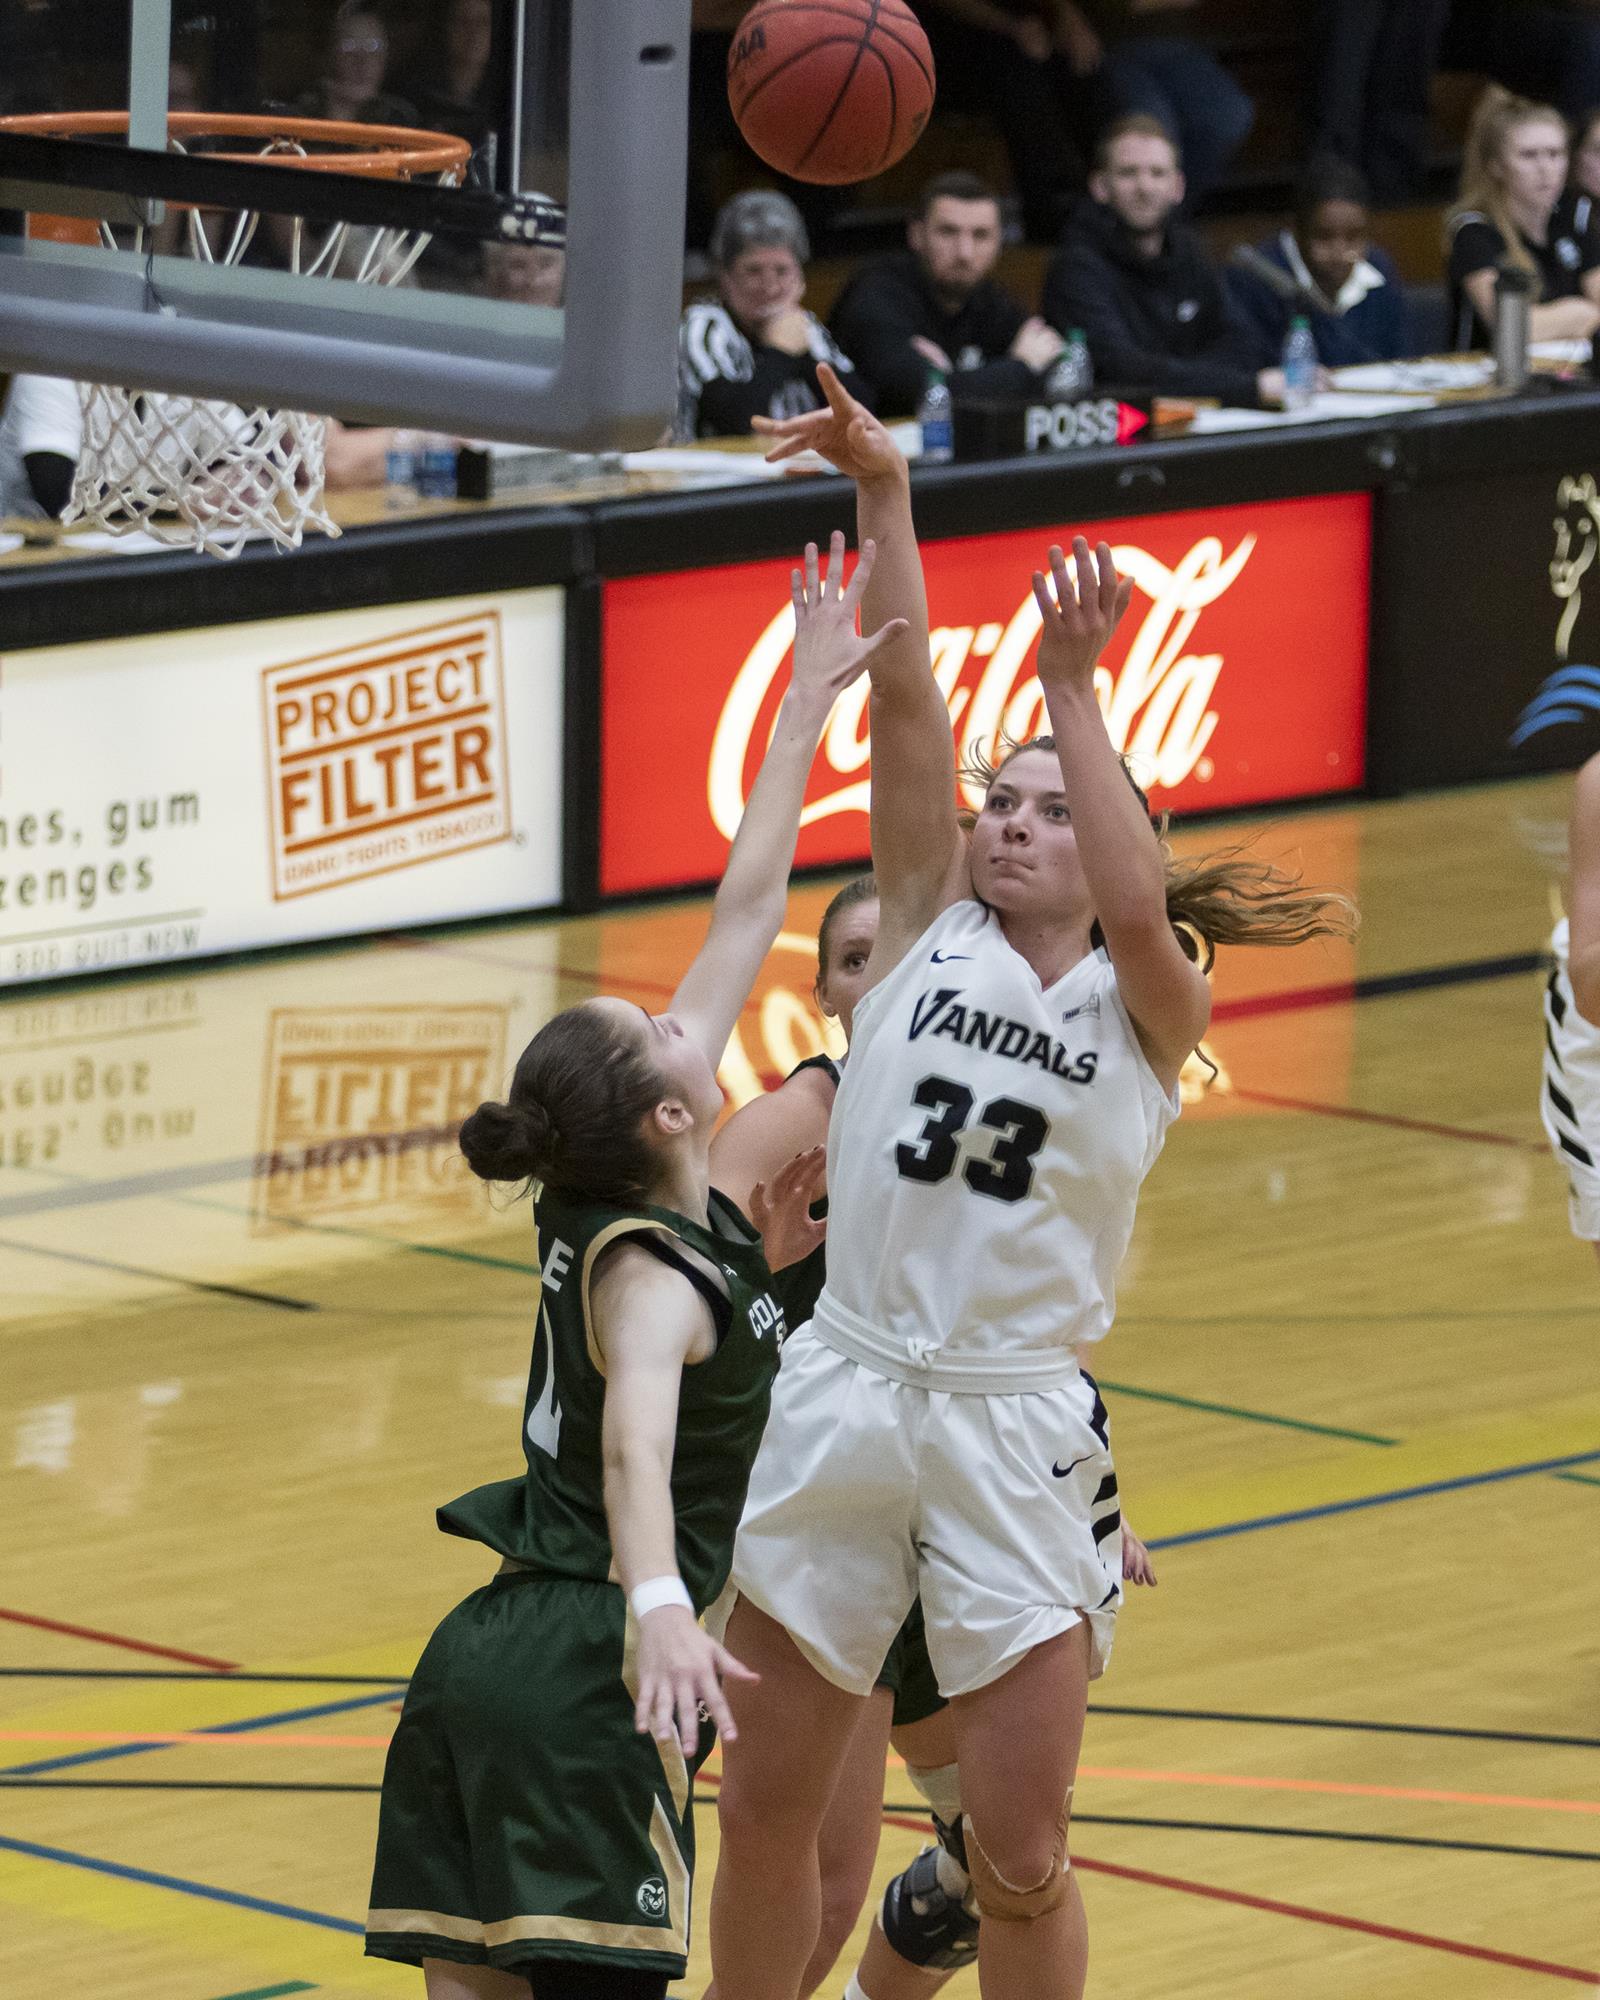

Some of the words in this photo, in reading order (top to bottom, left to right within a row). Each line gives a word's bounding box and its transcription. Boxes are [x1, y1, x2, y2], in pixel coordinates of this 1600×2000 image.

[1025, 398, 1118, 451] POSS
[276, 651, 486, 747] PROJECT
[108, 791, 199, 846] gum
[281, 723, 493, 837] FILTER
[908, 988, 1099, 1086] VANDALS
[894, 1072, 1053, 1206] 33
